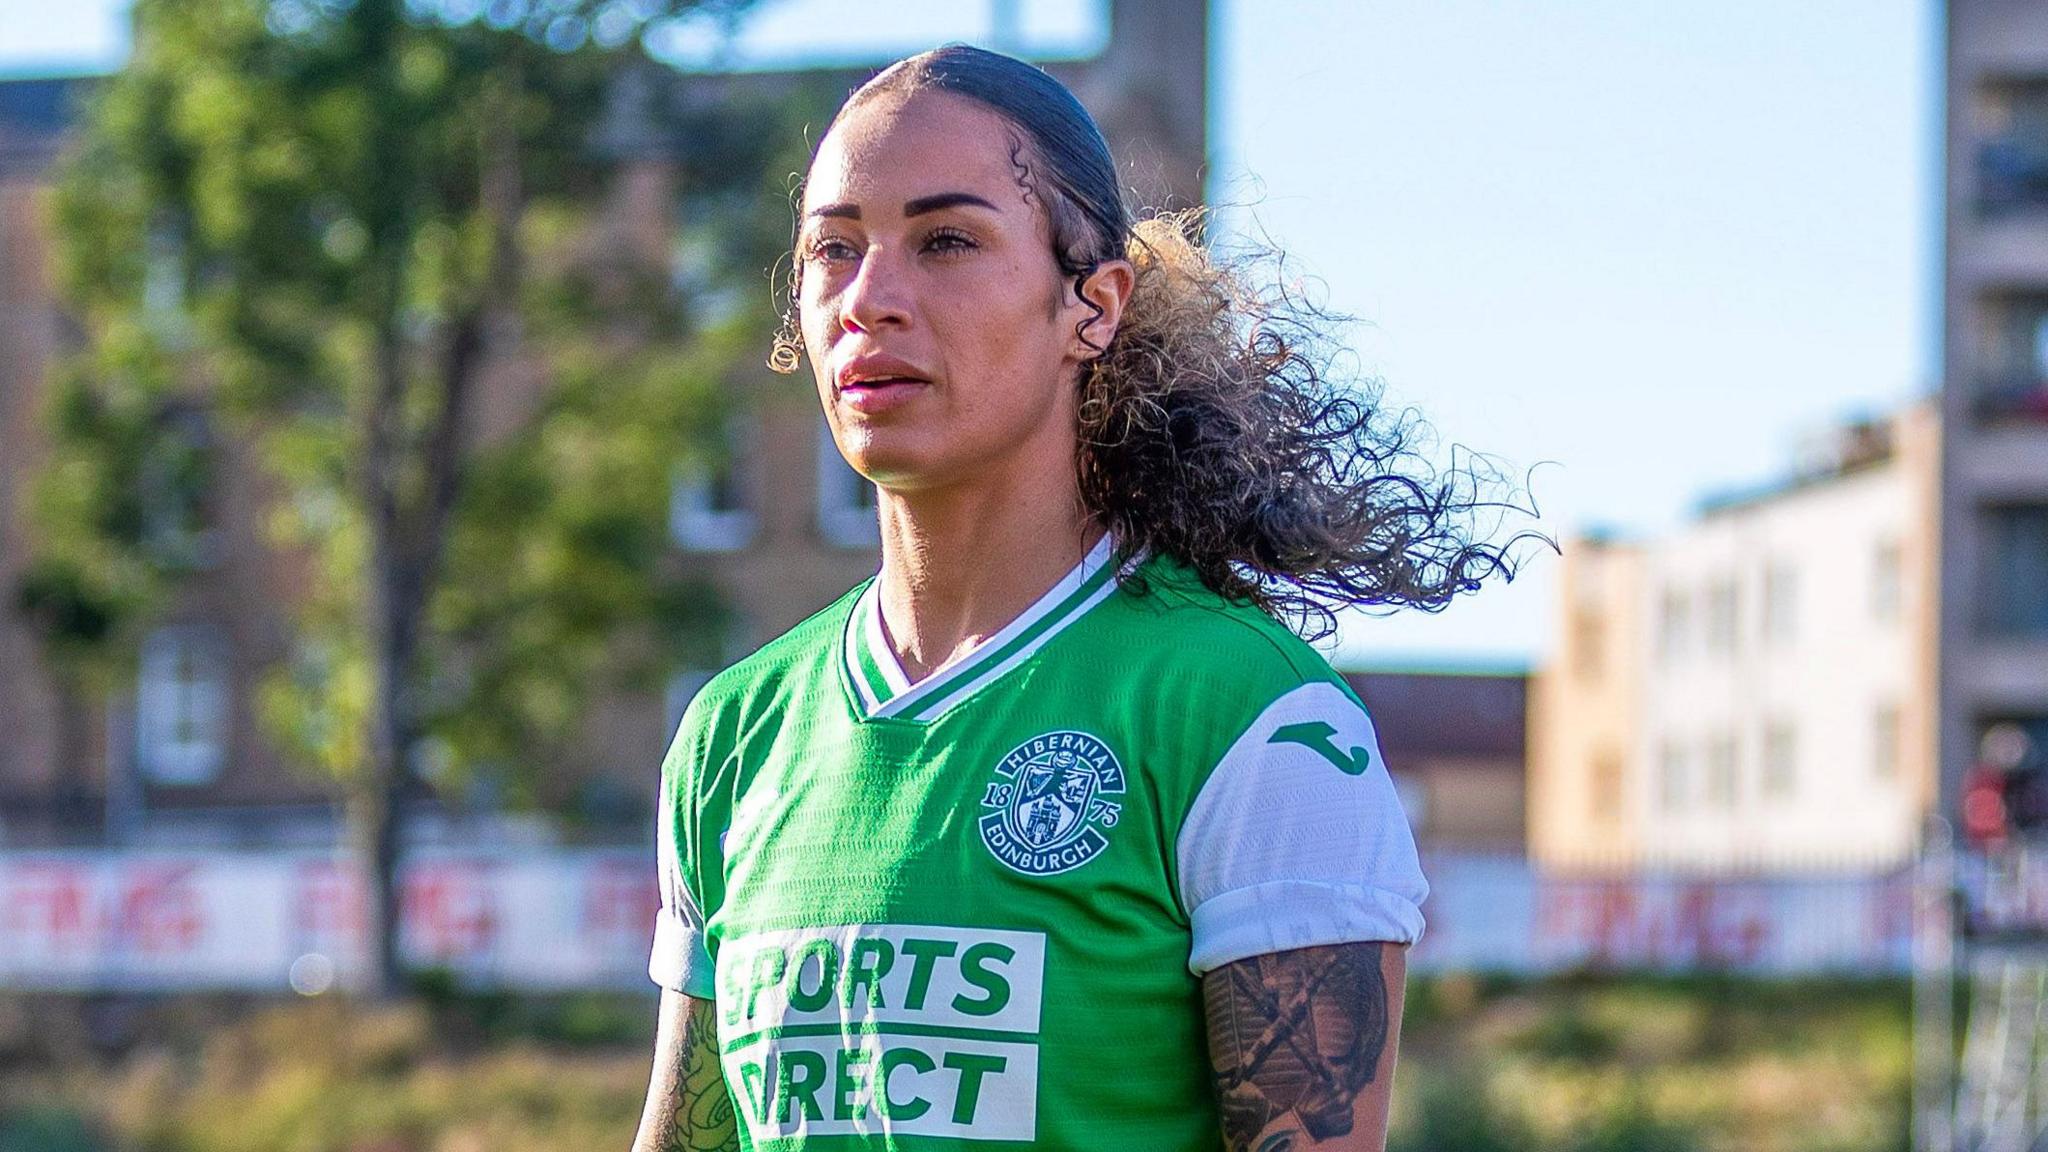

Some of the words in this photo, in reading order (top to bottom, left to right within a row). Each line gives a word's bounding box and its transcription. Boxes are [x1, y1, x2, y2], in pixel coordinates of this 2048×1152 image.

[1006, 734, 1118, 784] HIBERNIAN
[981, 783, 1013, 808] 18
[1088, 798, 1122, 827] 75
[986, 823, 1093, 871] EDINBURGH
[724, 937, 1016, 1026] SPORTS
